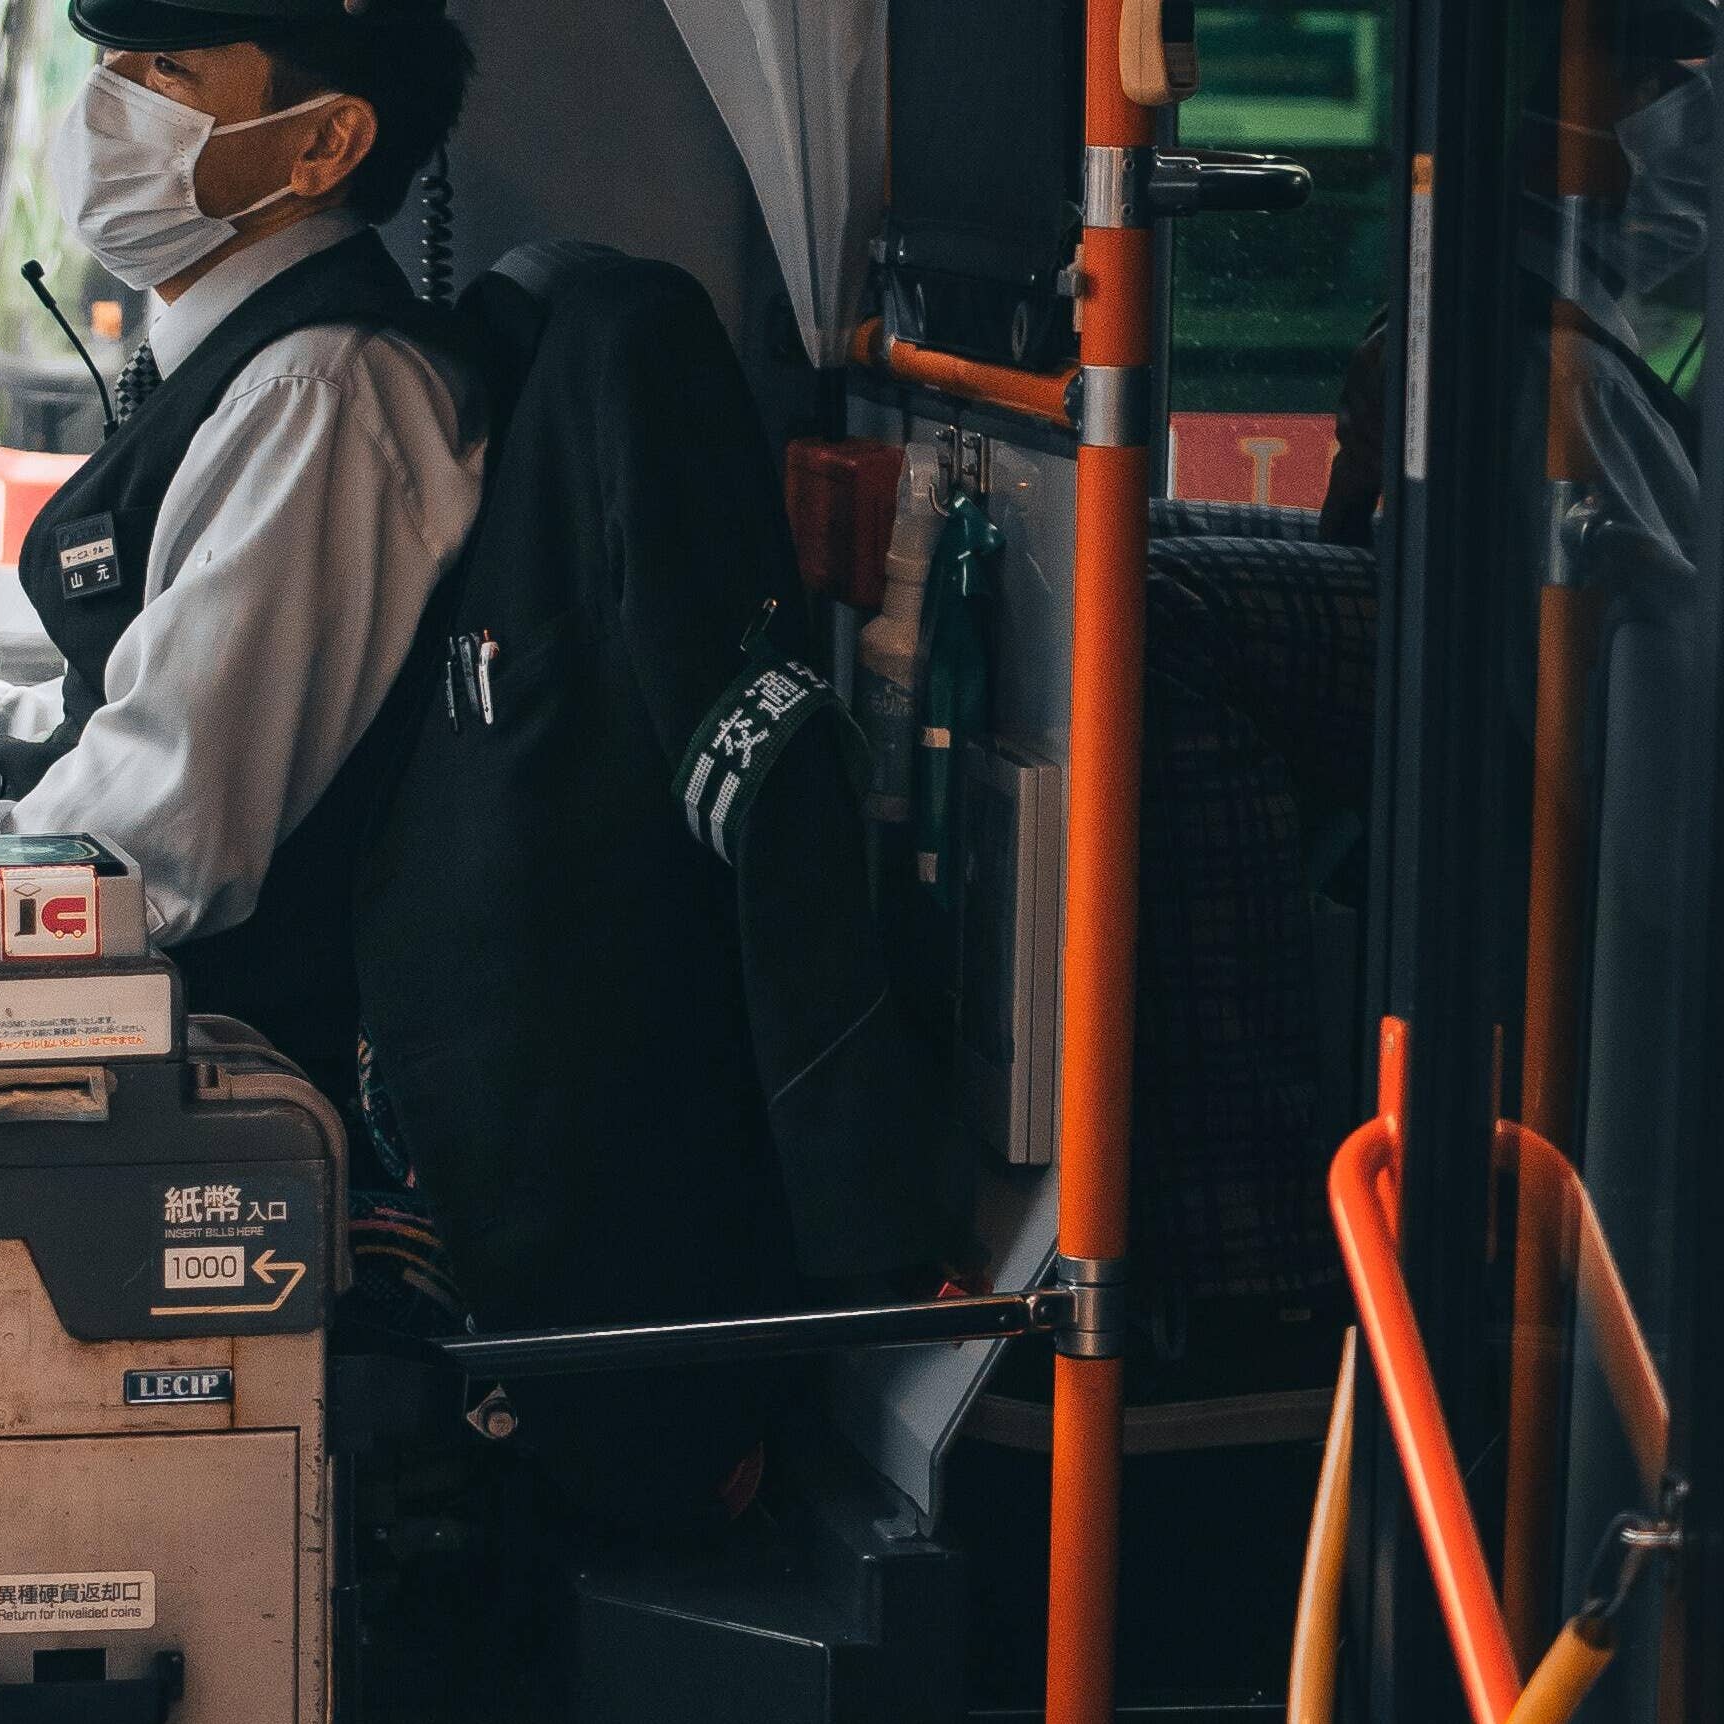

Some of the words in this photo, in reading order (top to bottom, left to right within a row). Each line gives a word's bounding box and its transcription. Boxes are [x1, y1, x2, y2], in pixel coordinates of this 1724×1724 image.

[164, 1184, 242, 1224] 紙幣
[246, 1201, 287, 1221] 入口
[164, 1228, 203, 1239] INSERT
[205, 1227, 236, 1237] BILLS
[237, 1226, 265, 1236] HERE
[172, 1254, 237, 1280] 1000
[139, 1374, 220, 1397] LECIP
[39, 1607, 55, 1620] for
[110, 1607, 142, 1618] coins
